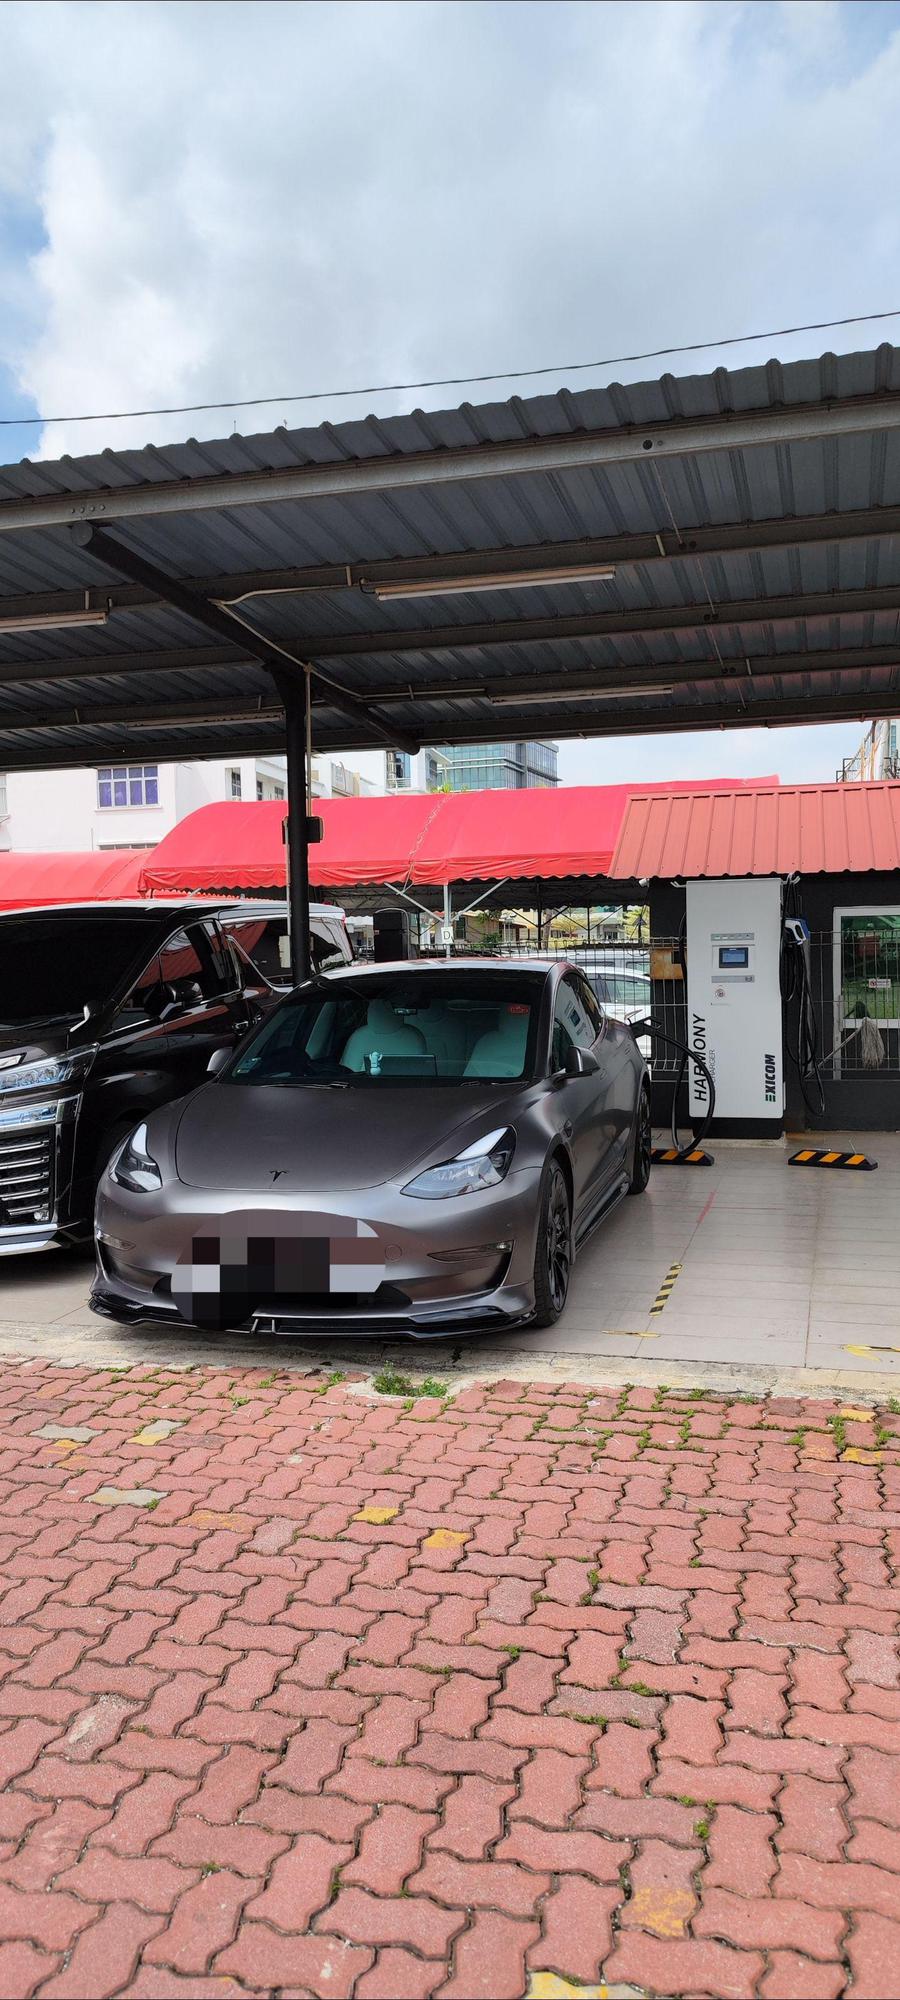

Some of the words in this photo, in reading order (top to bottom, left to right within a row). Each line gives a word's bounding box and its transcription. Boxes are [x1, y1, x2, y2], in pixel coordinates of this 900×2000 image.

[443, 930, 450, 940] D
[693, 1013, 706, 1101] HARMONY
[764, 1054, 776, 1102] EXICOM
